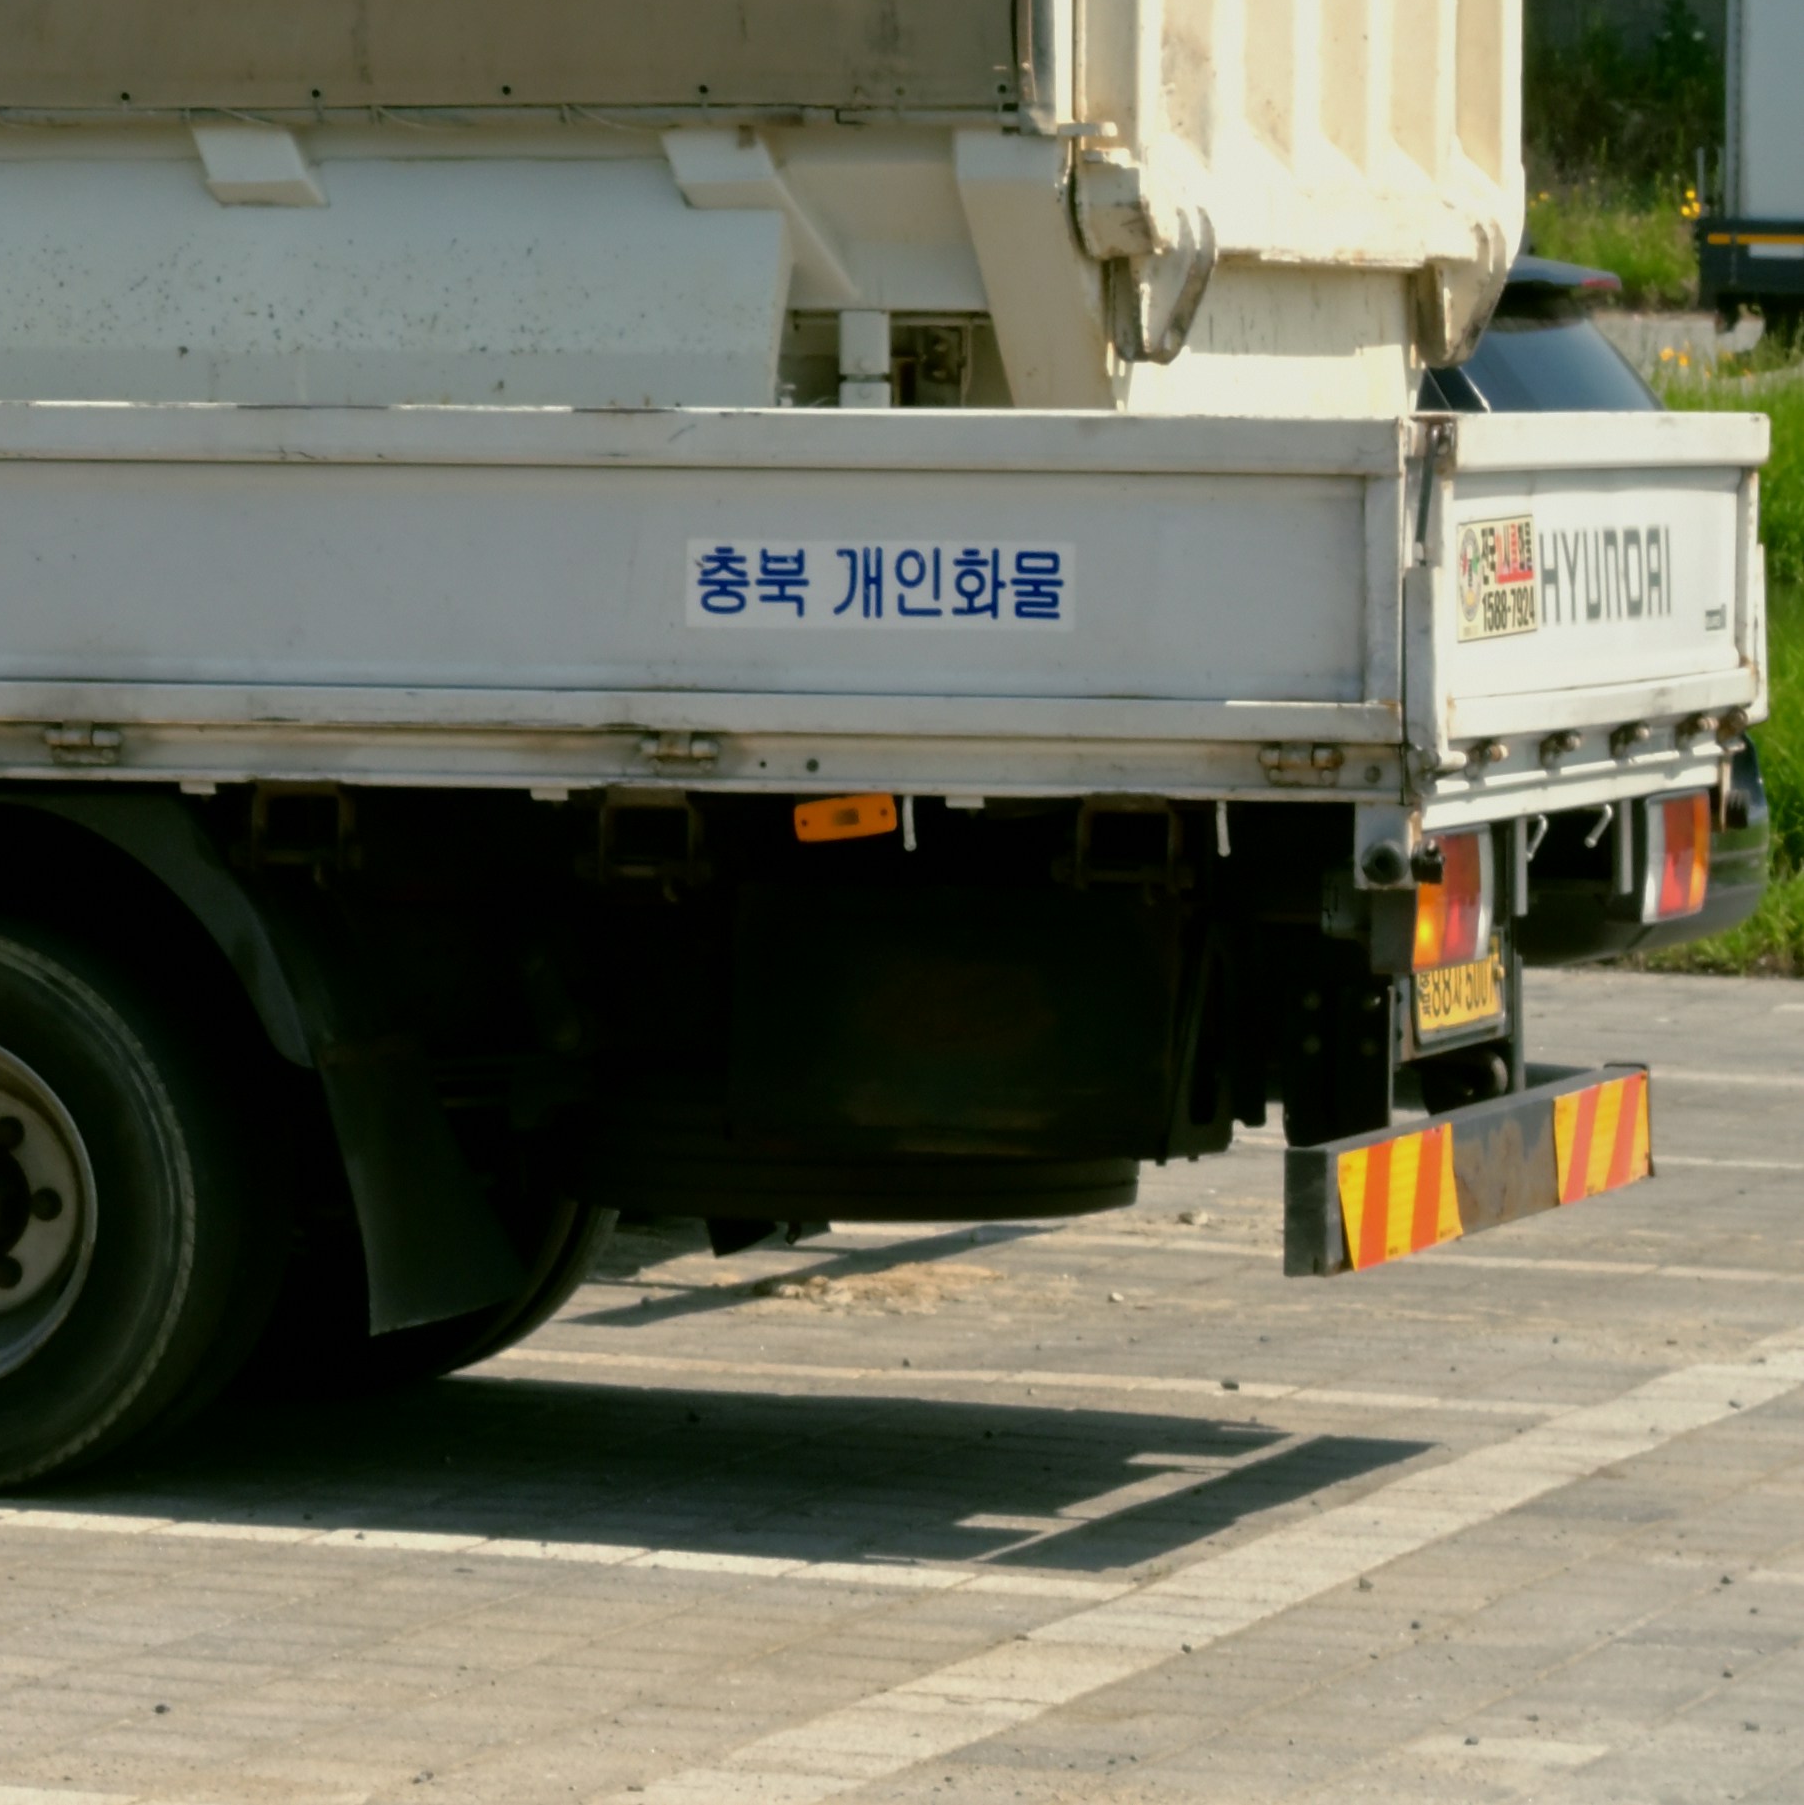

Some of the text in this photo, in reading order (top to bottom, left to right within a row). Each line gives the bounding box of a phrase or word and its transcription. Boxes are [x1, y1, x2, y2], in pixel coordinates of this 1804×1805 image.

[697, 546, 1065, 621] 충북 개인화물
[1482, 585, 1536, 633] 1588-7924
[1539, 524, 1671, 626] HYUNDAI
